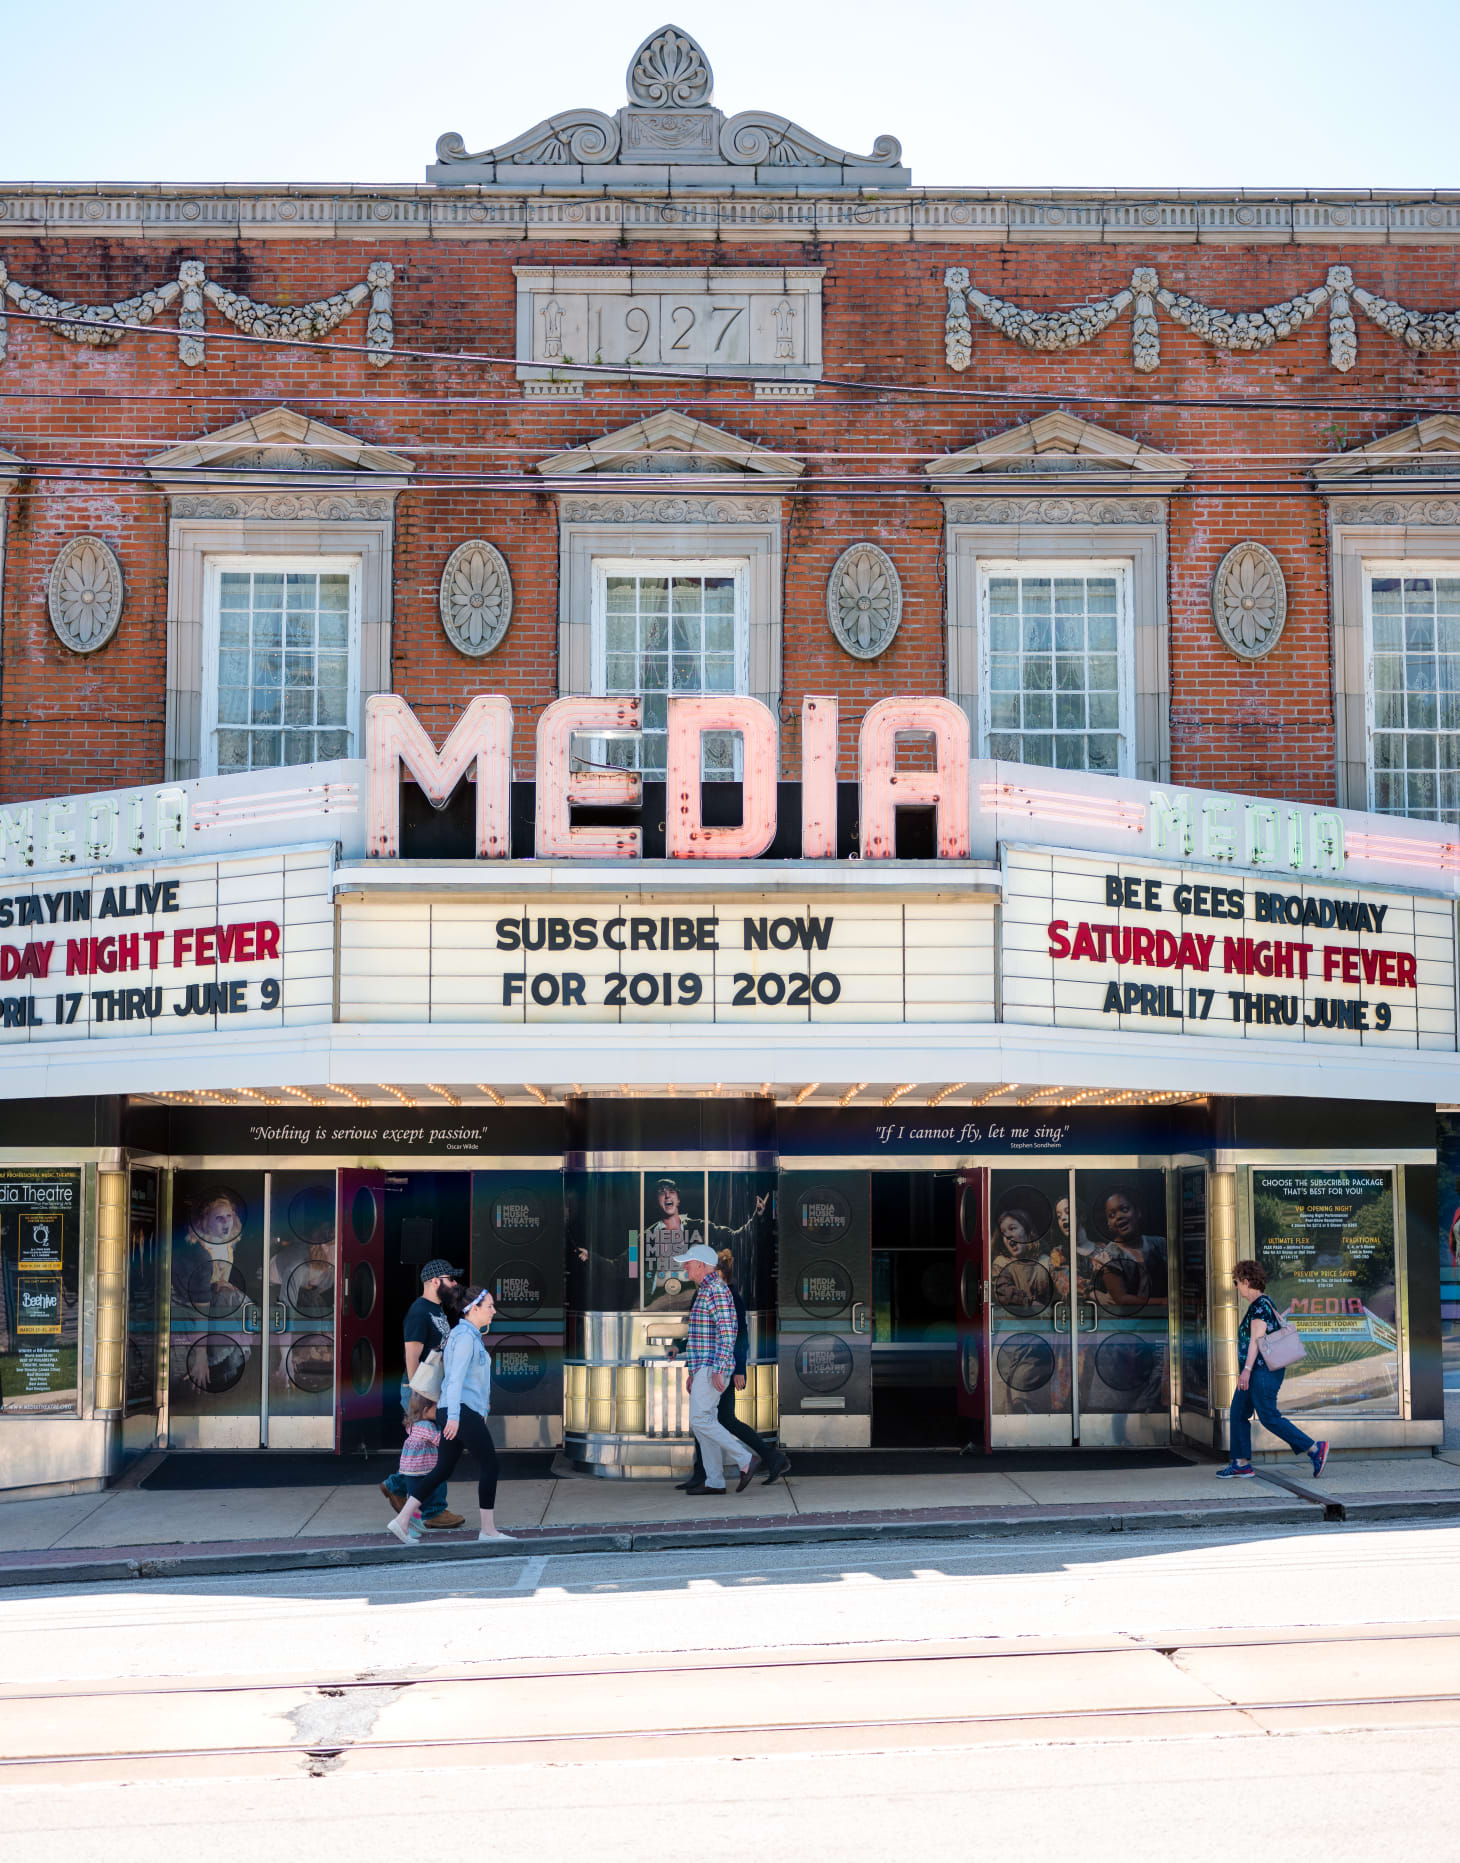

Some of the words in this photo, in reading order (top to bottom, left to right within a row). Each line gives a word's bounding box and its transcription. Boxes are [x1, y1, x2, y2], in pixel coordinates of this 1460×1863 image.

[595, 305, 745, 355] 1927
[365, 694, 971, 860] MEDIA
[0, 787, 188, 867] MEDIA
[1150, 790, 1345, 870] MEDIA
[0, 888, 91, 928] STAYIN
[98, 880, 180, 919] ALIVE
[1105, 874, 1162, 912] BEE
[1173, 884, 1244, 919] GEES
[1255, 891, 1388, 933] BROADWAY
[66, 931, 164, 976] NIGHT
[173, 921, 281, 968] FEVER
[495, 918, 720, 951] SUBSCRIBE
[743, 917, 834, 951] NOW
[1048, 919, 1216, 972] SATURDAY
[1224, 936, 1313, 980] NIGHT
[1324, 945, 1417, 989] FEVER
[0, 995, 42, 1028] RIL
[56, 992, 83, 1025] 17
[92, 986, 162, 1022] THRU
[173, 980, 247, 1018] JUNE
[260, 977, 281, 1010] 9
[502, 972, 586, 1006] FOR
[604, 972, 703, 1006] 2019
[732, 972, 842, 1006] 2020
[1103, 981, 1182, 1018] APRIL
[1188, 987, 1215, 1020] 17
[1228, 991, 1297, 1026] THRU
[1303, 997, 1369, 1031] JUNE
[1375, 1002, 1392, 1031] 9
[250, 1125, 311, 1144] "Nothing
[315, 1126, 327, 1140] is
[331, 1126, 377, 1140] serious
[382, 1128, 424, 1143] except
[428, 1125, 488, 1143] passion."
[876, 1124, 896, 1144] "If
[897, 1126, 905, 1139] I
[909, 1127, 955, 1139] cannot
[956, 1124, 982, 1143] fly,
[988, 1124, 1005, 1138] let
[1011, 1127, 1029, 1138] me
[1034, 1125, 1070, 1142] sing."
[22, 1184, 73, 1201] Theatre
[1283, 1187, 1308, 1195] THAT'S
[1310, 1187, 1325, 1195] BEST
[1328, 1187, 1343, 1195] FOR
[1346, 1187, 1363, 1195] YOU!
[1310, 1178, 1350, 1186] SUBSCRIBER
[1352, 1178, 1384, 1186] PACKAGE
[646, 1230, 703, 1244] MEDIA
[646, 1243, 689, 1257] MUSI
[1342, 1236, 1381, 1244] TRADITIONAL
[22, 1292, 57, 1309] Beehive
[1290, 1298, 1364, 1314] MEDIA
